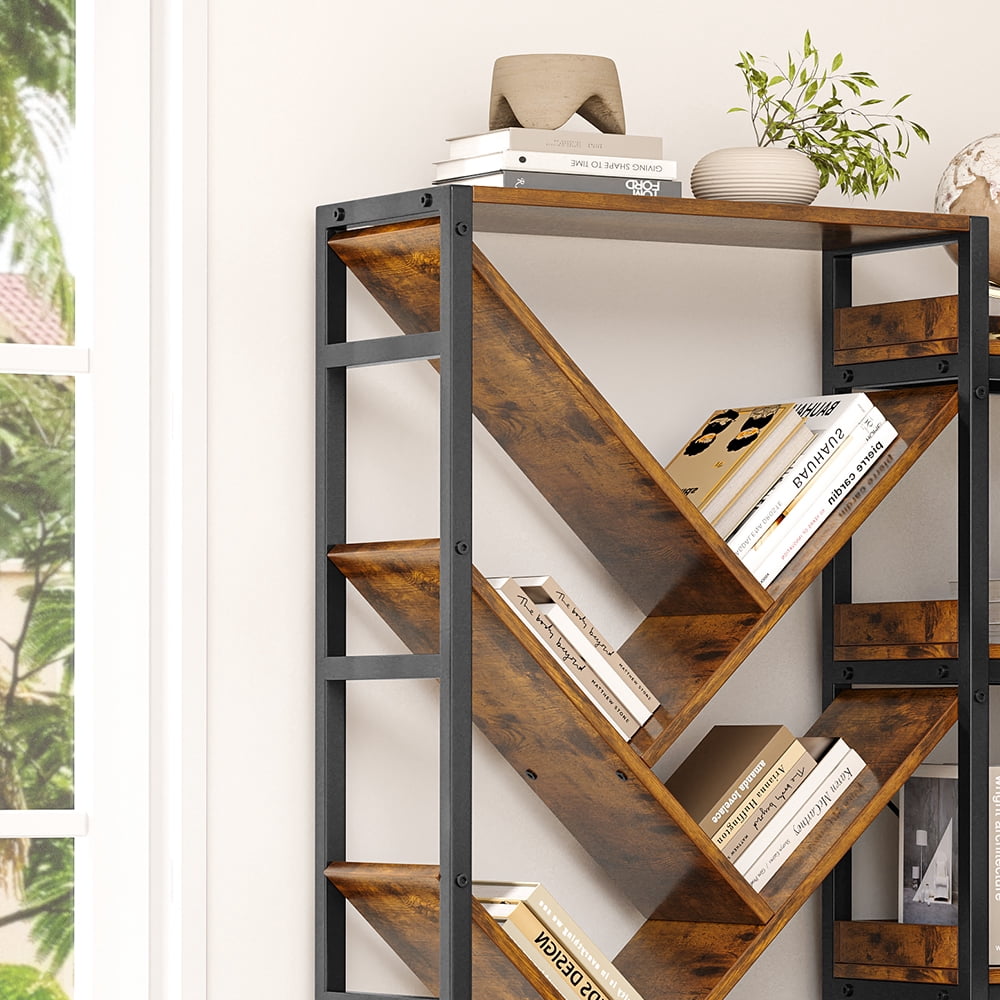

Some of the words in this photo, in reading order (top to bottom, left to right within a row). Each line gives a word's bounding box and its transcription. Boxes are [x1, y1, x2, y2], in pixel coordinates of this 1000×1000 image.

[570, 160, 588, 168] TIME
[591, 161, 602, 169] TO
[604, 162, 630, 171] SHAPE
[632, 164, 662, 172] GIVING
[626, 179, 660, 192] FORD
[555, 590, 570, 609] The
[572, 608, 588, 629] body
[589, 628, 614, 656] beyond
[618, 663, 638, 685] MATTHEW
[638, 685, 651, 700] STONE
[516, 594, 534, 616] The
[535, 614, 554, 639] body
[556, 637, 586, 671] beyond
[591, 679, 614, 705] MATTHEW
[614, 705, 631, 723] STONE
[740, 760, 766, 792] amanda
[756, 764, 786, 798] Arianna
[792, 767, 806, 782] The
[830, 767, 853, 793] Karen
[777, 784, 792, 801] body
[711, 790, 742, 824] lovelace
[753, 802, 778, 830] beyond
[793, 792, 832, 836] McCartney
[716, 798, 758, 844] Huffington
[730, 835, 749, 855] MATTHEW
